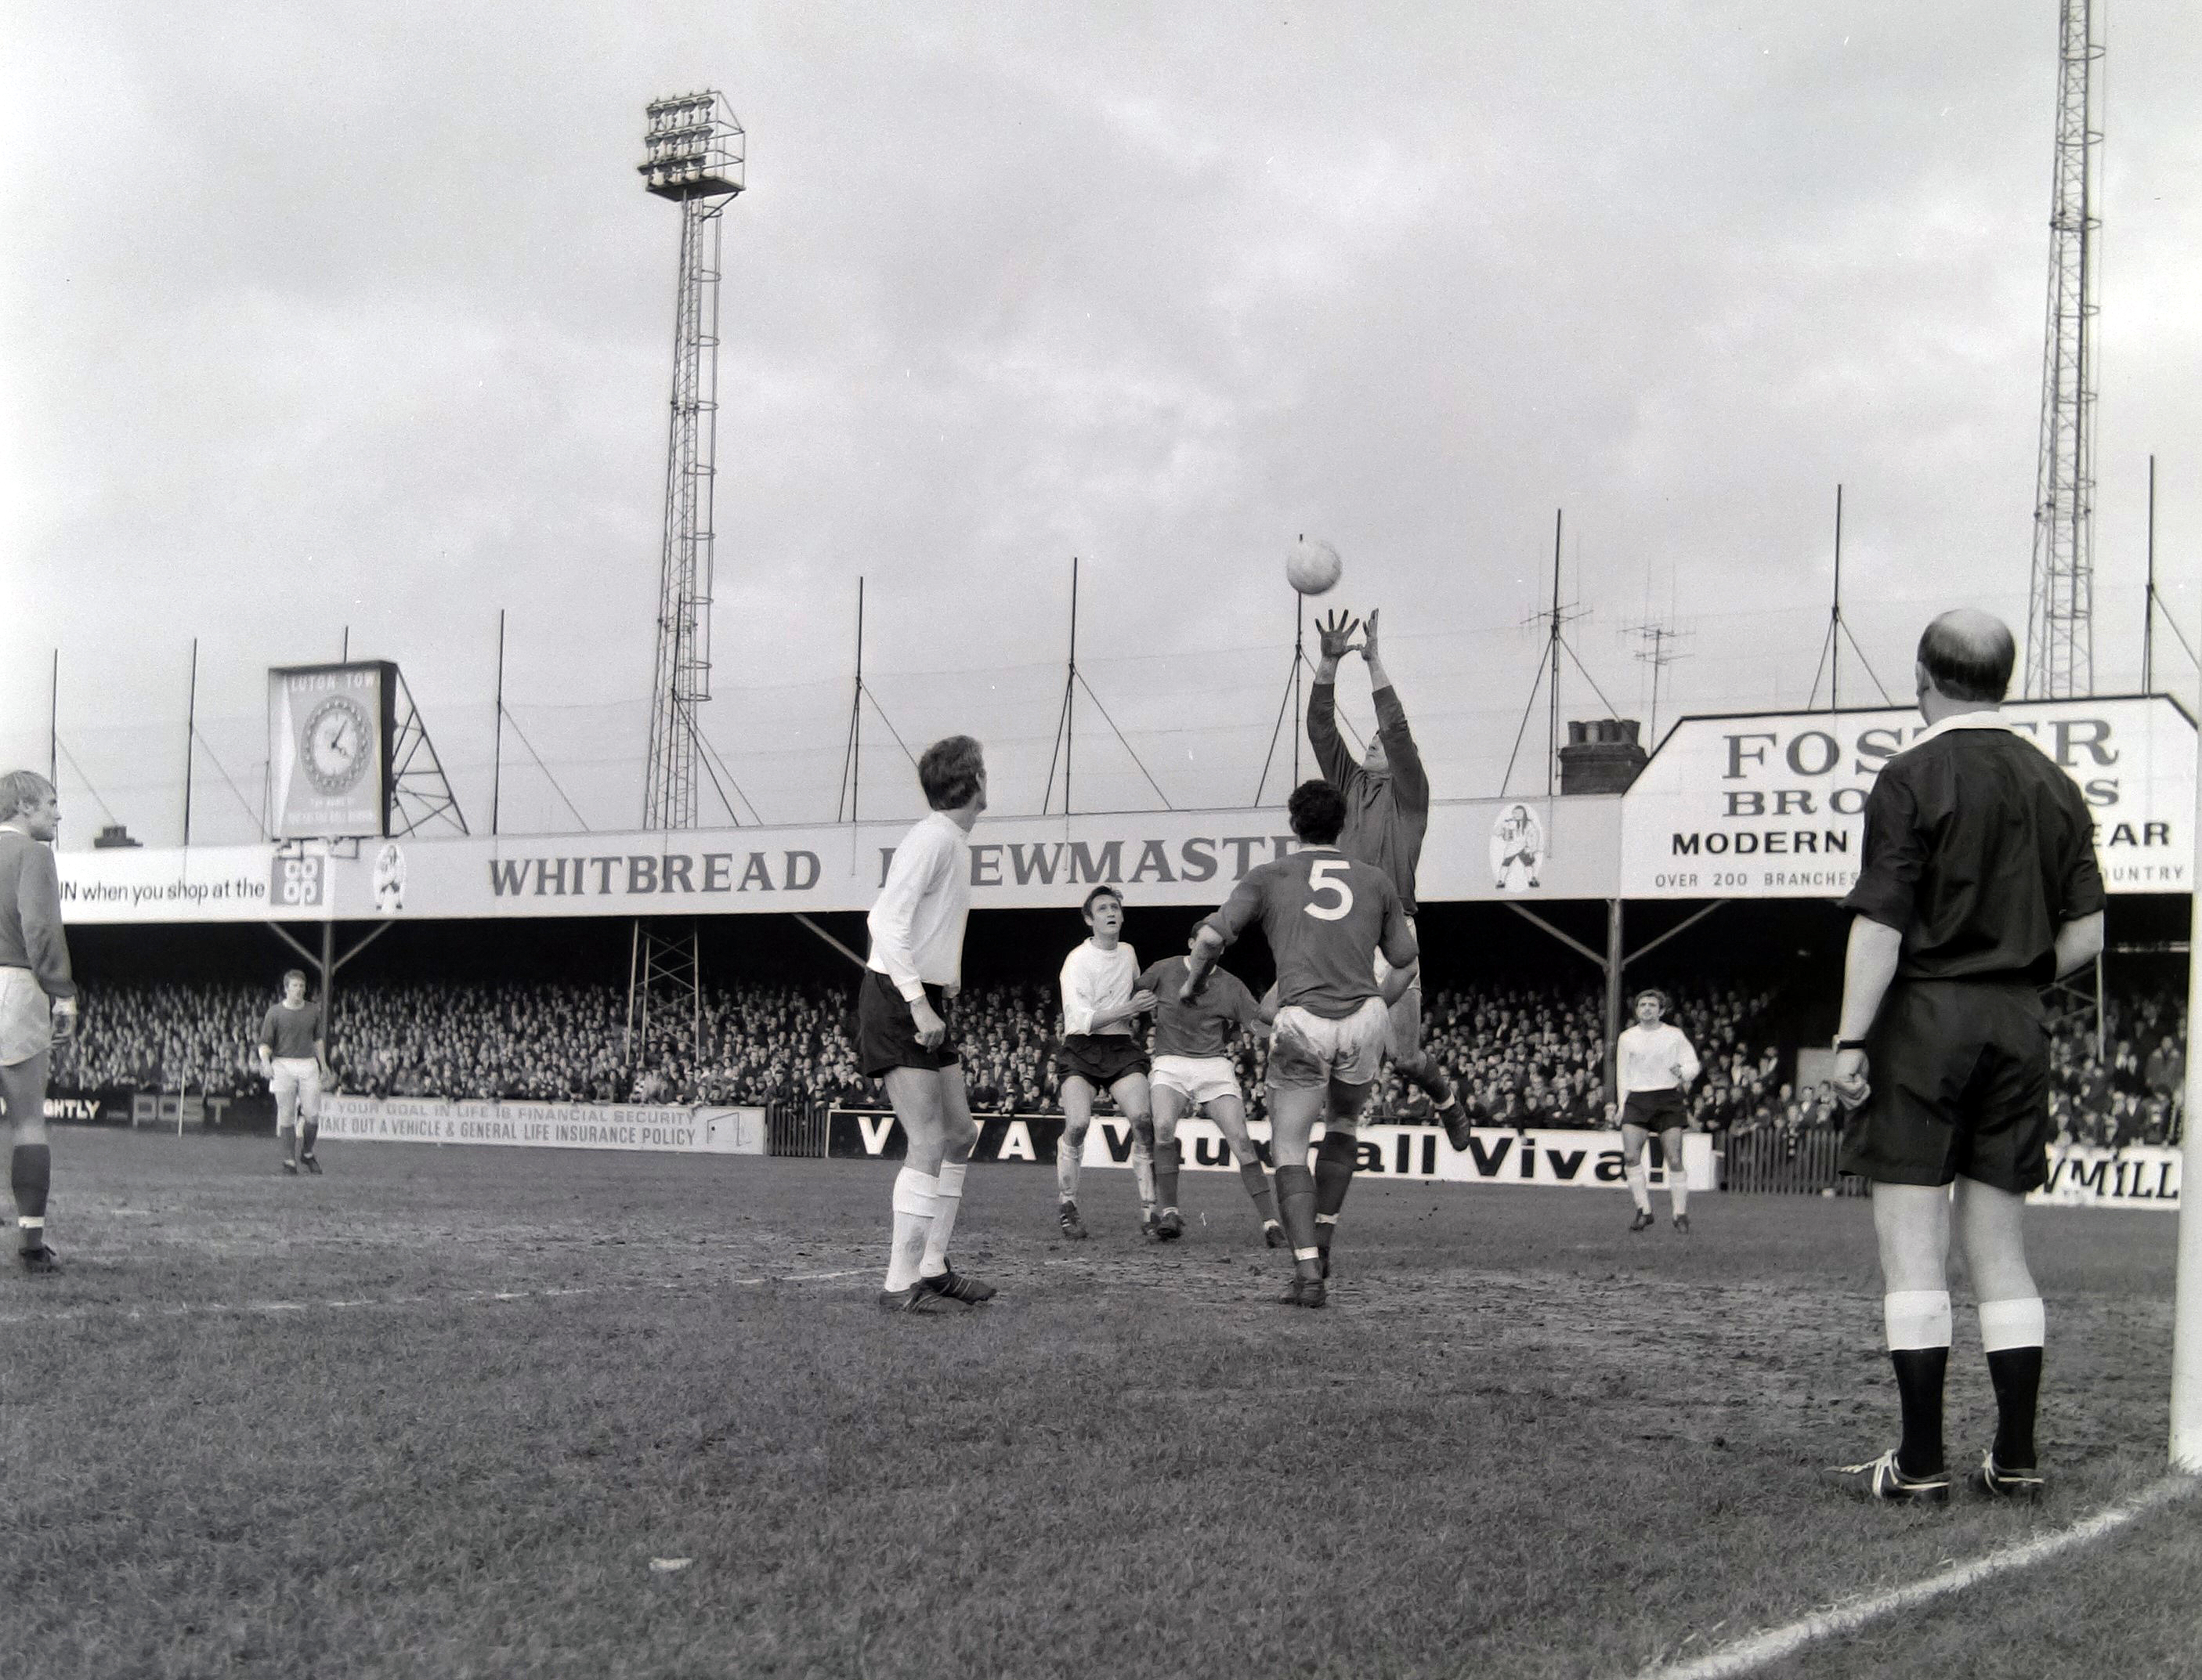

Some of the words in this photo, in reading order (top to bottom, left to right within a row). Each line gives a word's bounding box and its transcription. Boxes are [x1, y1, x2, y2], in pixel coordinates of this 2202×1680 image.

[1723, 718, 2119, 779] FOSR
[1672, 830, 1847, 855] MODERN
[489, 850, 821, 896] WHITBREAD
[1655, 873, 1698, 887] OVER
[1713, 873, 1748, 886] 200
[82, 880, 128, 901] when
[132, 883, 163, 906] you
[168, 879, 208, 906] shop
[212, 880, 230, 898] at
[237, 877, 265, 898] the
[1303, 860, 1354, 920] 5
[338, 1102, 379, 1114] YOUR
[386, 1103, 427, 1116] GOAL
[435, 1104, 450, 1118] IN
[457, 1104, 488, 1118] LIFE
[518, 1107, 608, 1122] FINANCIAL
[613, 1110, 696, 1125] SECURITY
[320, 1116, 347, 1133] TAKE
[353, 1118, 375, 1134] OUT
[379, 1119, 388, 1134] A
[391, 1120, 440, 1136] VEHICLE
[447, 1122, 454, 1136] &
[461, 1122, 517, 1140] GENERAL
[523, 1125, 550, 1141] LIFE
[556, 1125, 636, 1144] INSURANCE
[642, 1128, 696, 1146] POLICY
